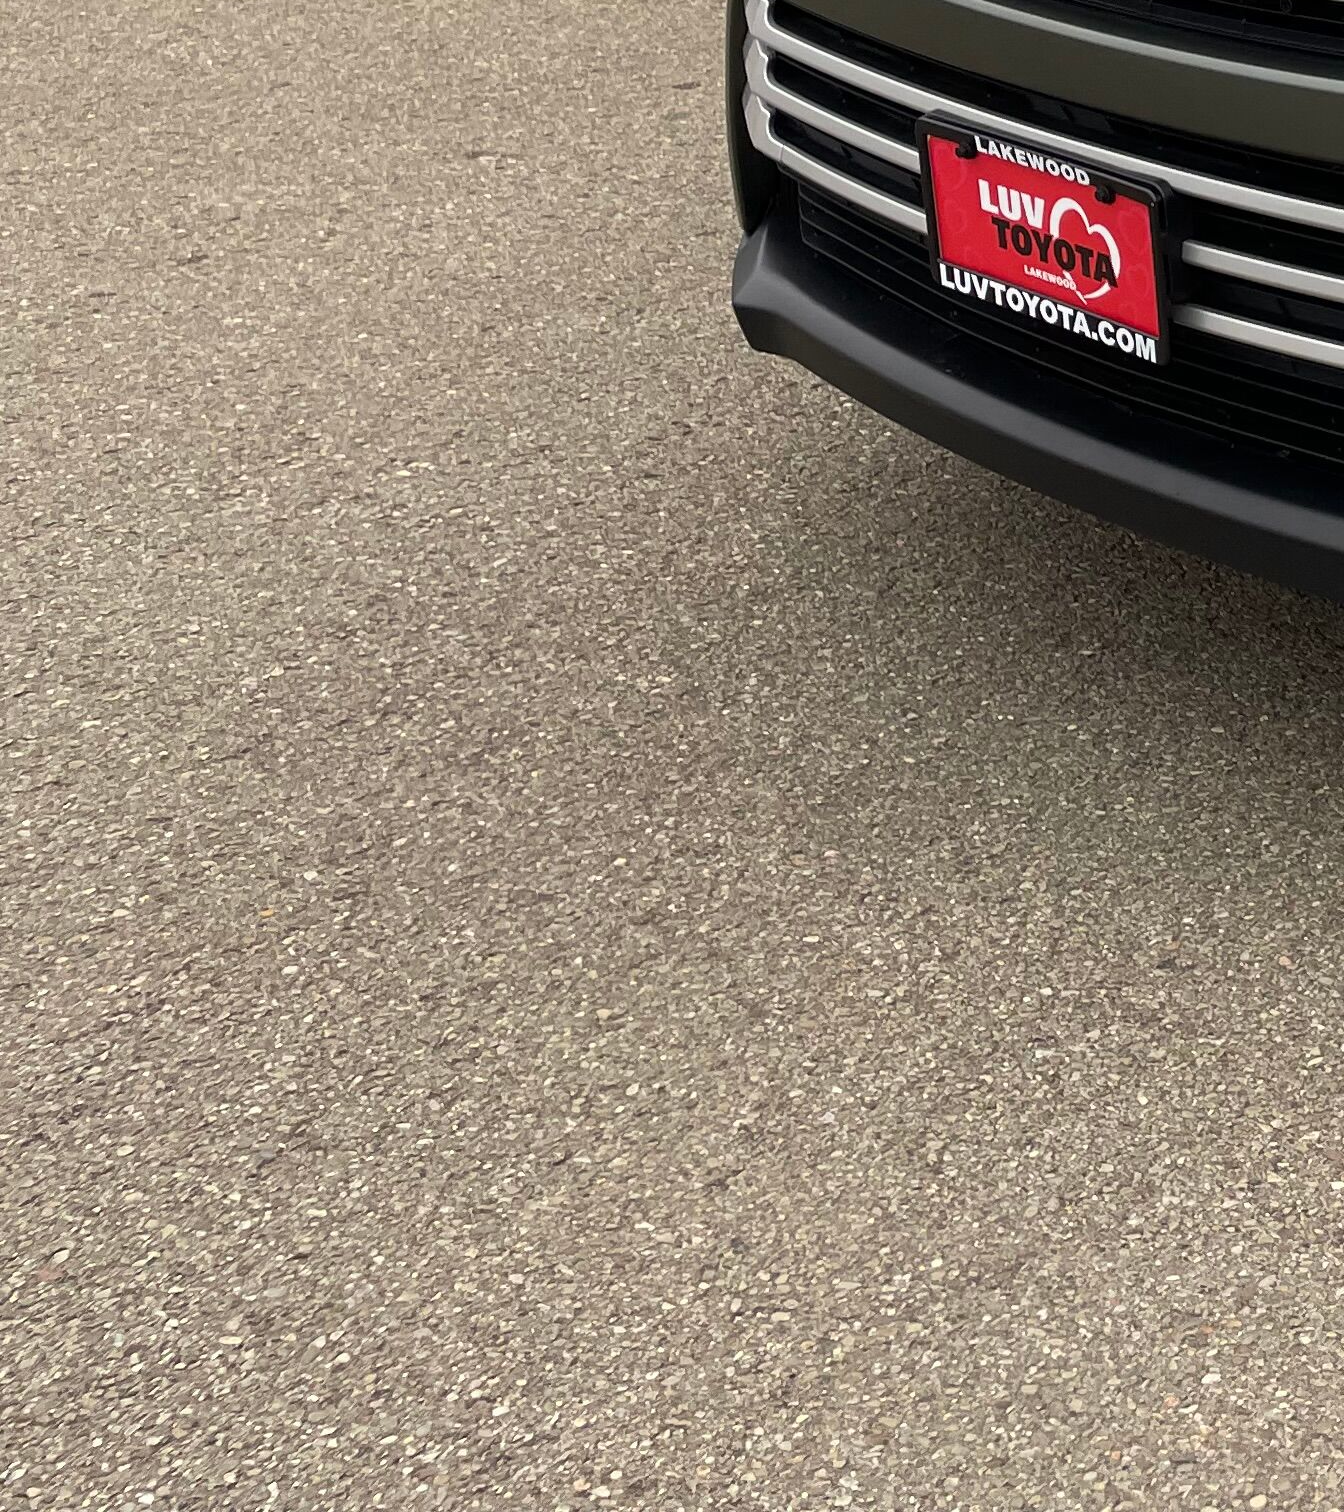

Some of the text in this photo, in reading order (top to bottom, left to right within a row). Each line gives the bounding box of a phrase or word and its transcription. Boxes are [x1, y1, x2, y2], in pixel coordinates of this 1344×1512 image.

[974, 136, 1090, 186] LAKEWOOD
[979, 179, 1045, 229] LUV
[991, 218, 1118, 287] TOYOTA
[1024, 264, 1076, 291] LAKEWOOD
[939, 263, 1156, 363] LUVTOYOTA.COM
